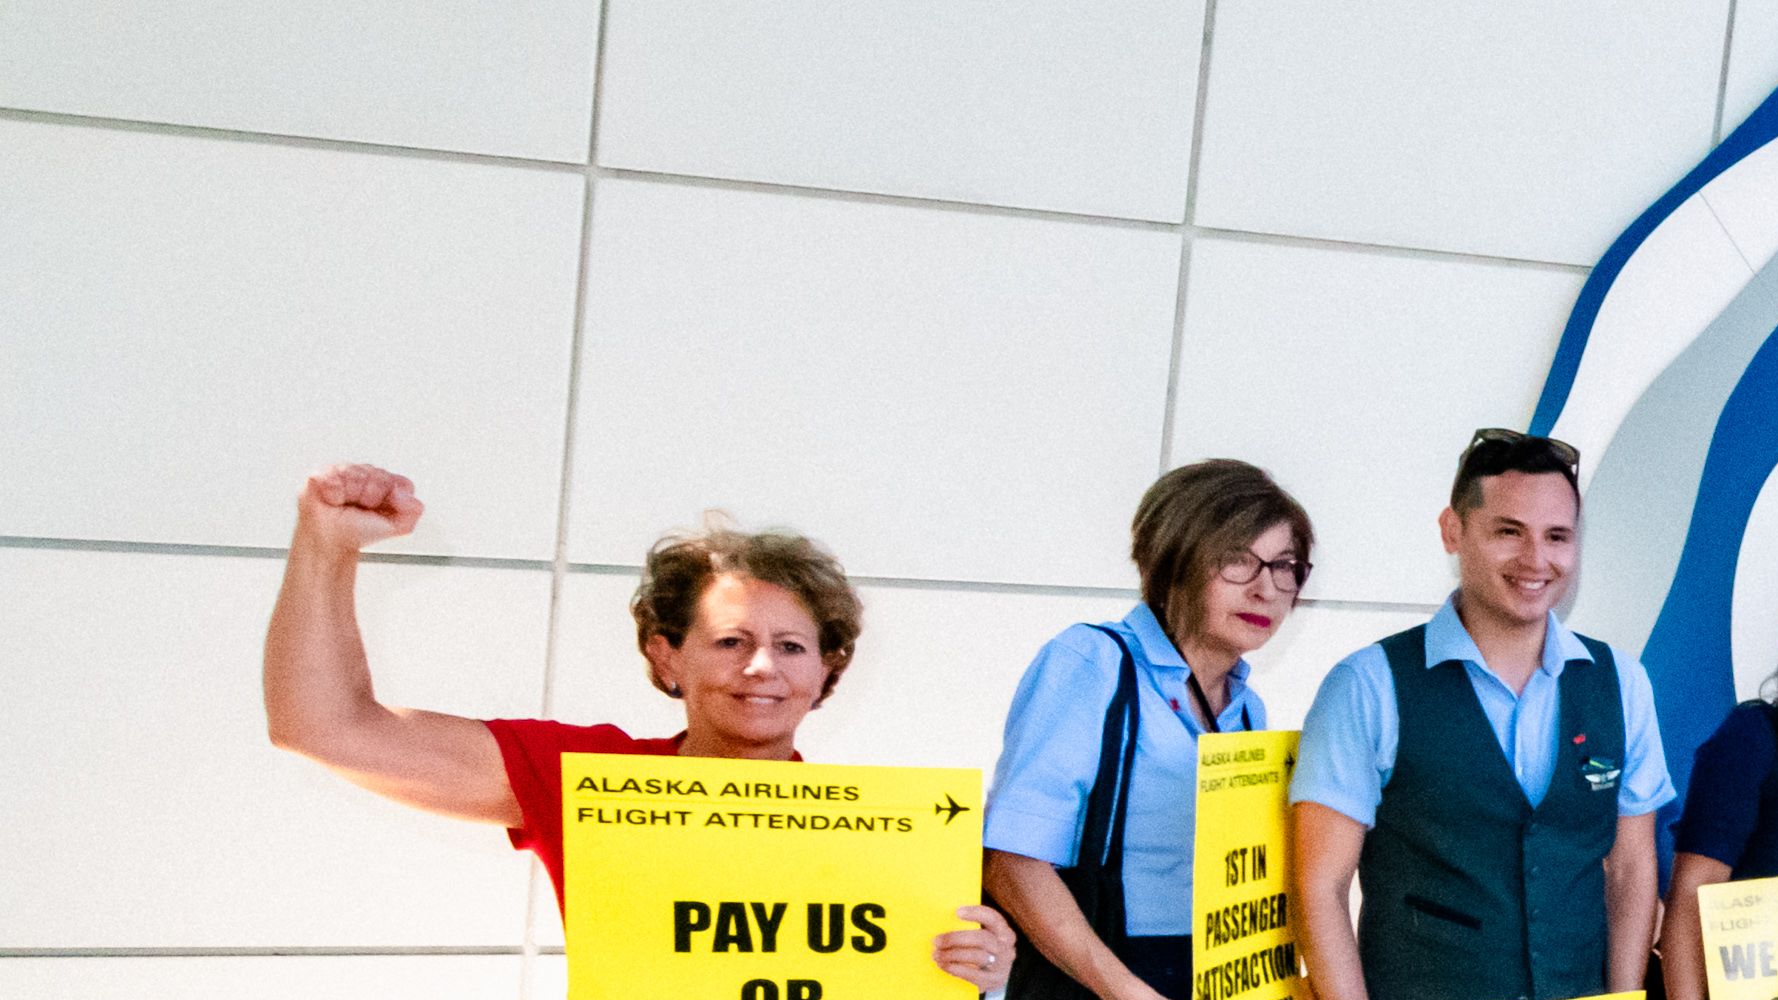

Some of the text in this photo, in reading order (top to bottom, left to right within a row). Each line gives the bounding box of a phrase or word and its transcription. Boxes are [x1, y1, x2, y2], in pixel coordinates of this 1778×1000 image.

[577, 777, 860, 801] ALASKA AIRLINES
[577, 808, 913, 833] FLIGHT ATTENDANTS
[1224, 844, 1267, 888] 1ST IN
[673, 901, 887, 953] PAY US
[1206, 892, 1287, 951] PASSENGER
[1719, 940, 1778, 981] WE
